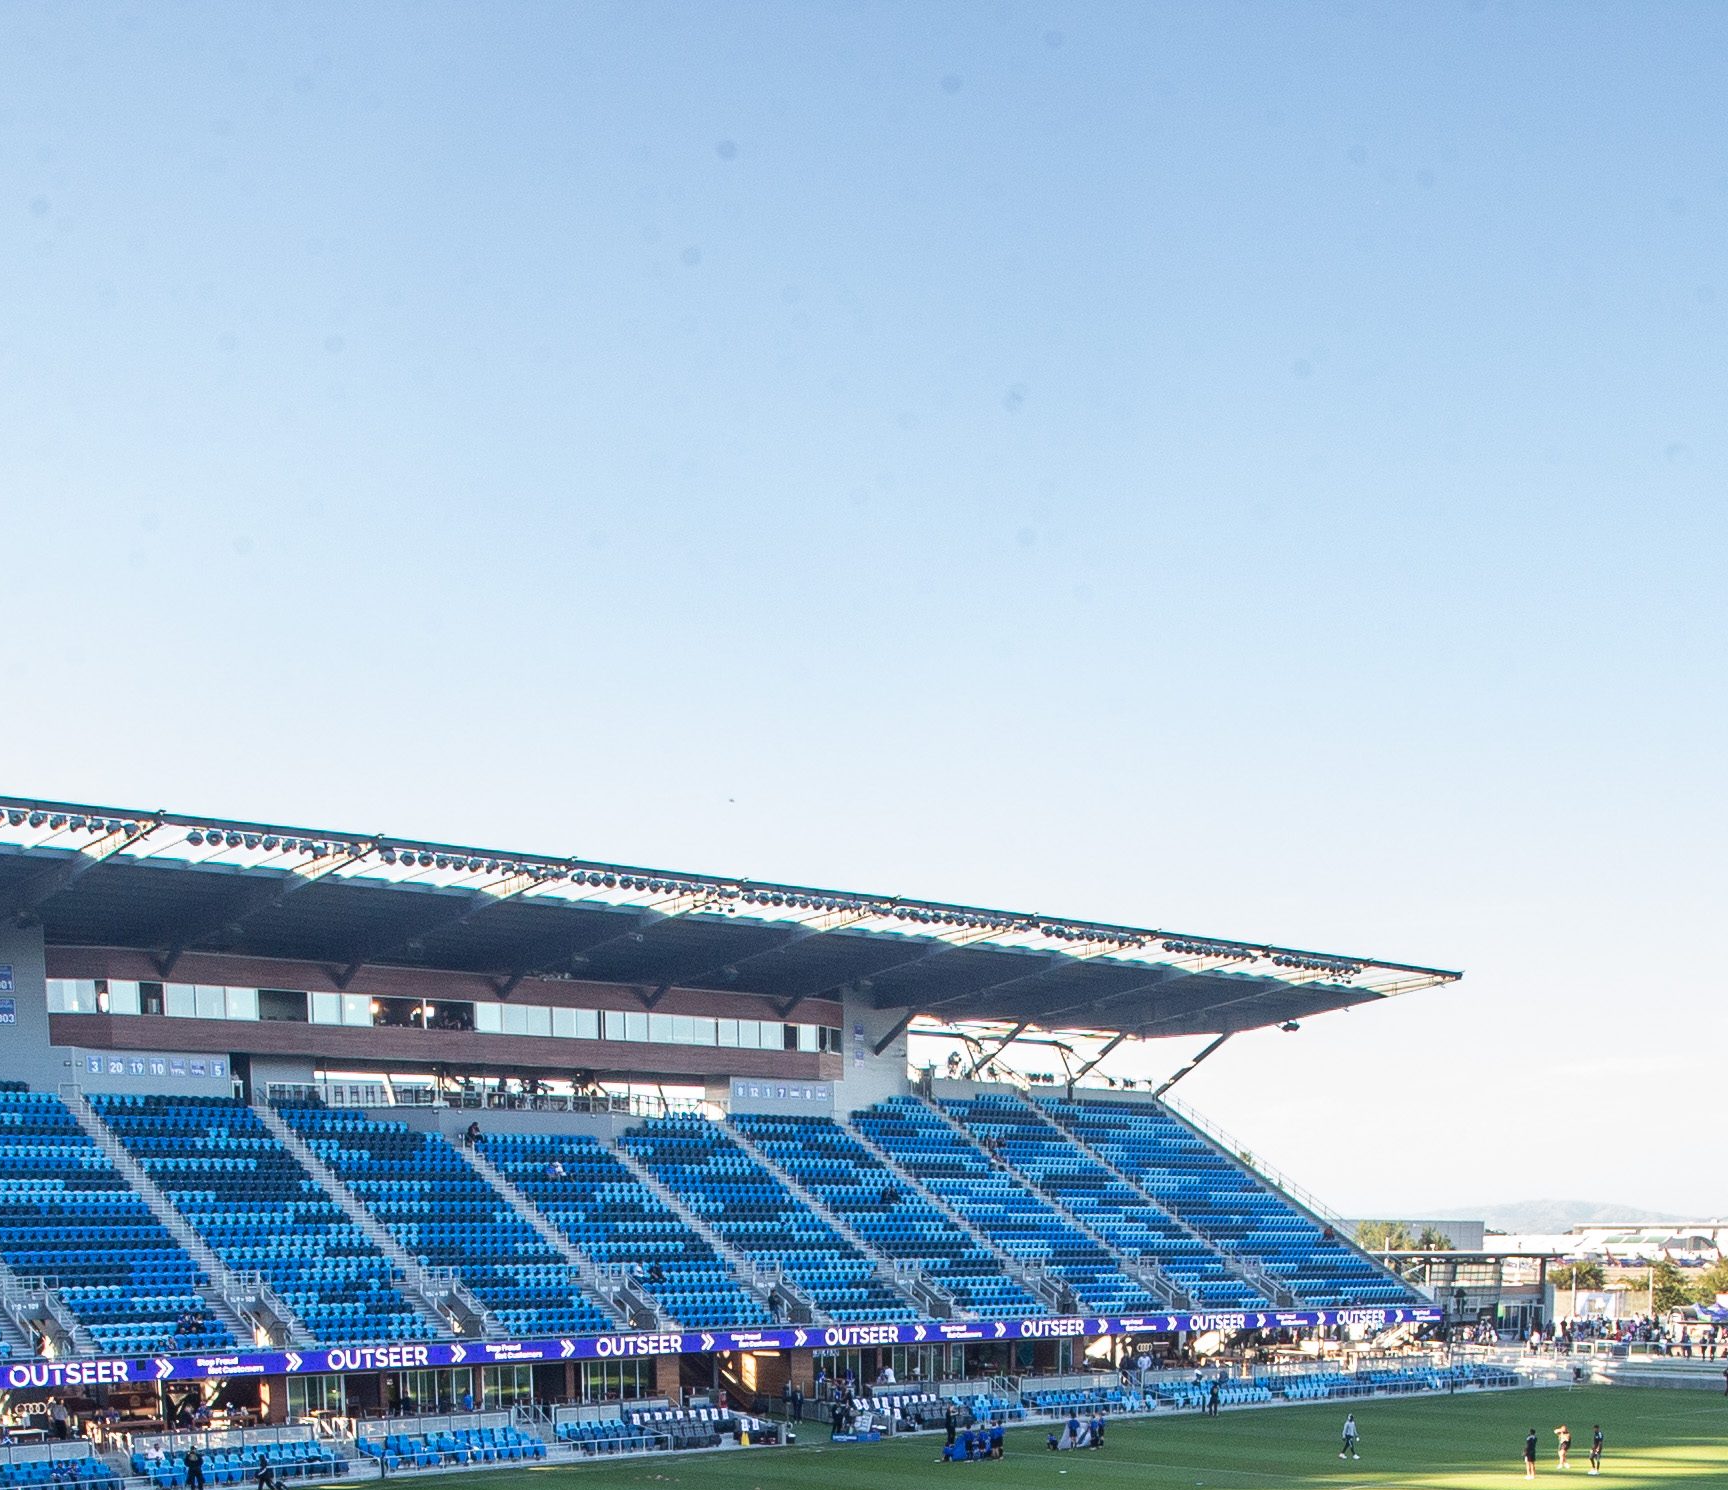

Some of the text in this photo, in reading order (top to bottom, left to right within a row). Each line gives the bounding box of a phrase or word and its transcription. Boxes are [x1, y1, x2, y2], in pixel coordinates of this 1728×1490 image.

[91, 1061, 99, 1072] 3
[110, 1062, 124, 1073] 20
[131, 1063, 144, 1073] 19
[151, 1063, 164, 1074] 10
[1190, 1313, 1246, 1331] OUTSEER
[1336, 1309, 1386, 1325] OUTSEER
[824, 1326, 899, 1346] OUTSEER
[1020, 1319, 1085, 1338] OUTSEER
[595, 1335, 683, 1357] OUTSEER
[196, 1356, 239, 1367] Stop Fraud
[327, 1346, 429, 1371] OUTSEER
[9, 1361, 129, 1388] OUTSEER
[207, 1365, 265, 1375] Not Customers
